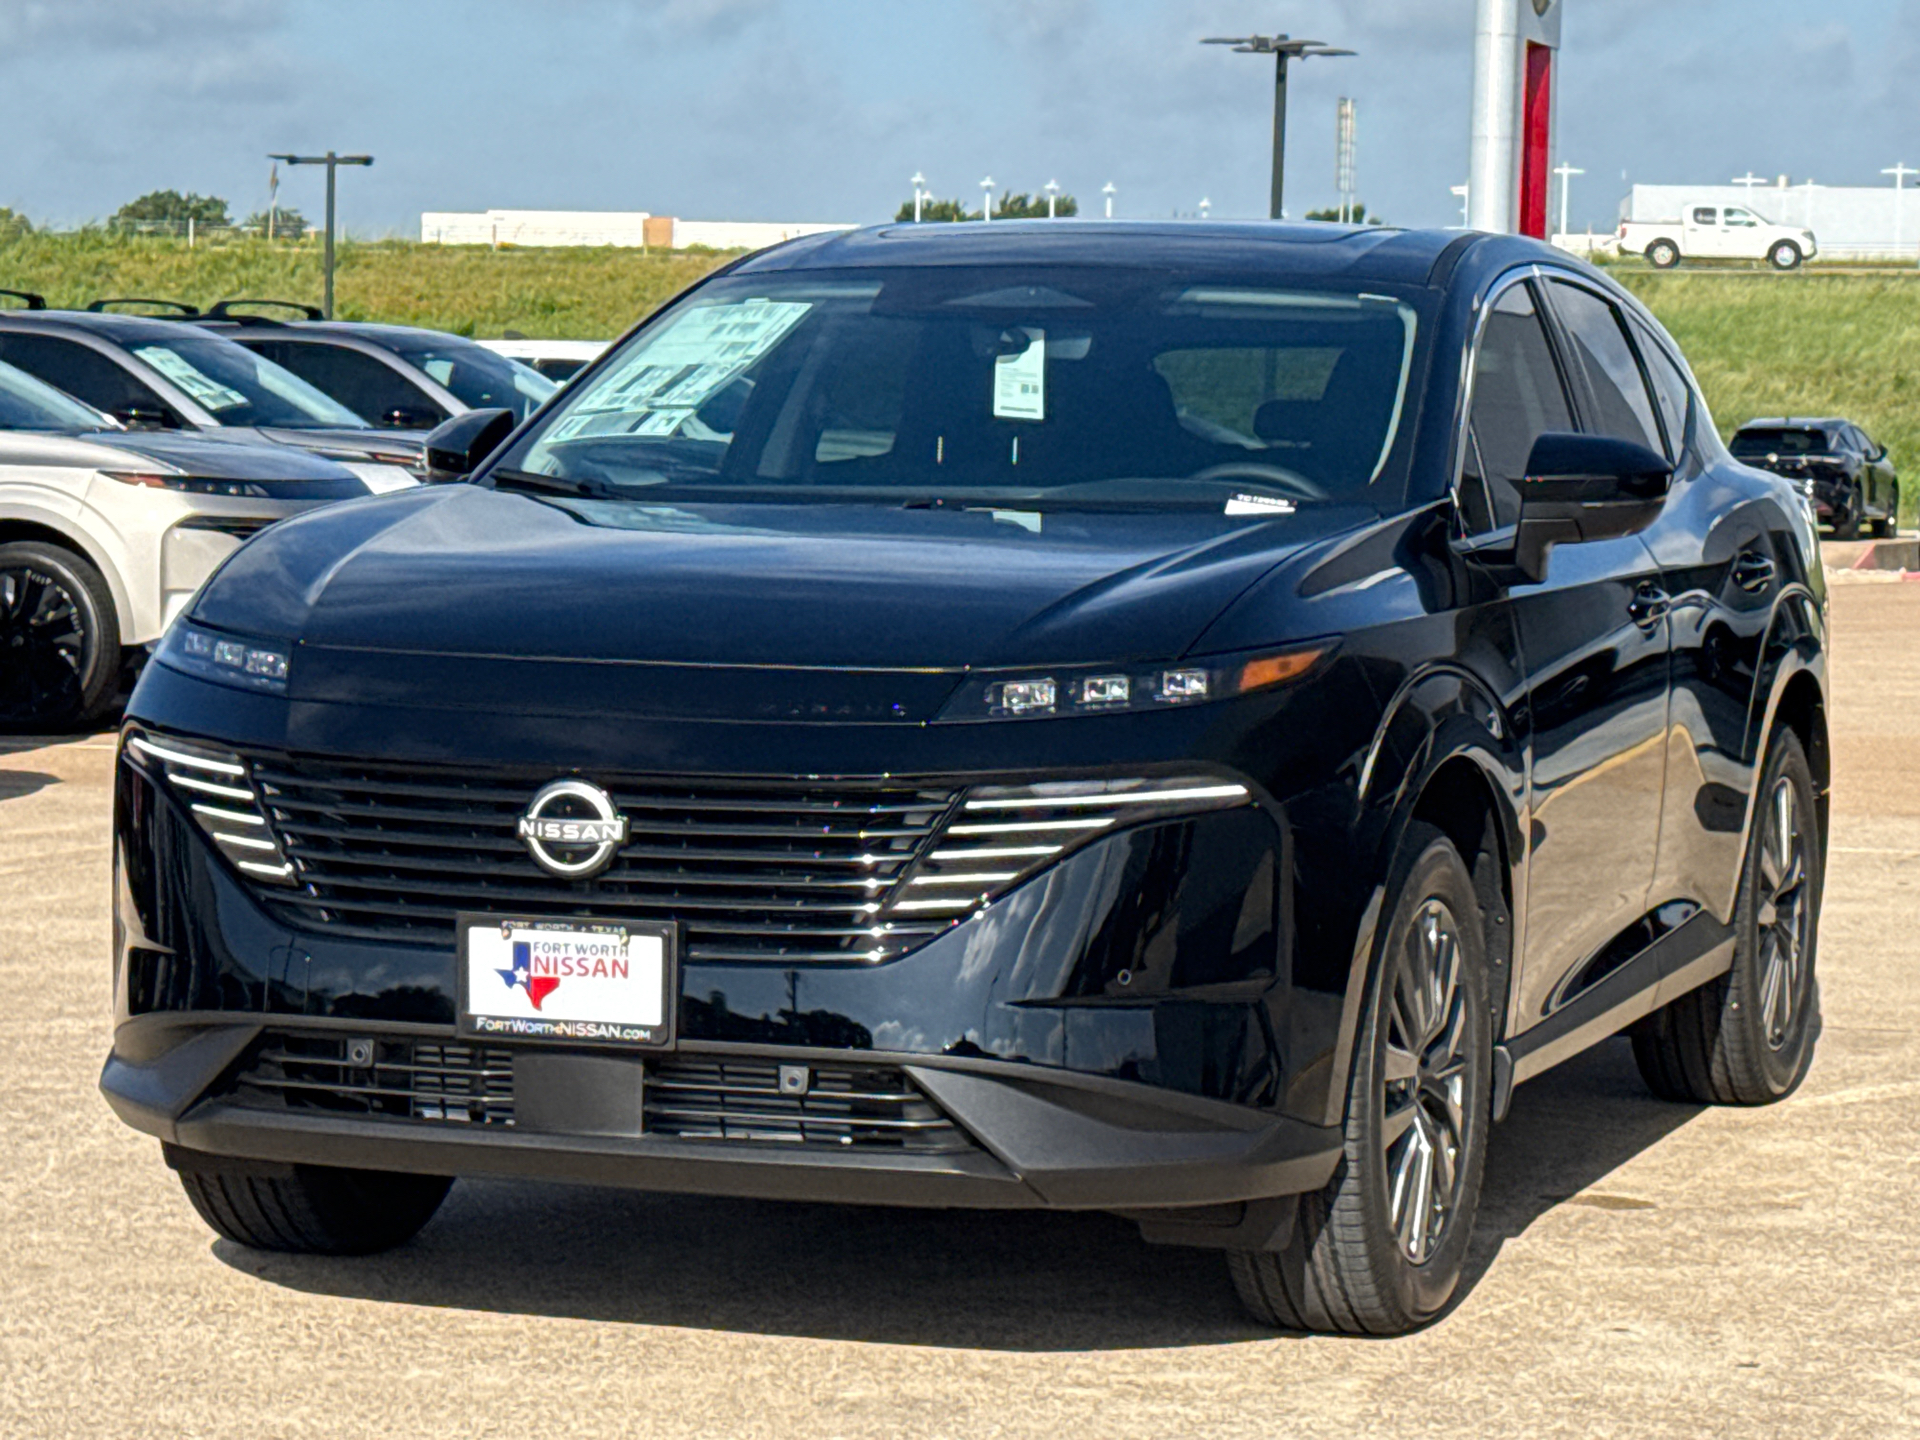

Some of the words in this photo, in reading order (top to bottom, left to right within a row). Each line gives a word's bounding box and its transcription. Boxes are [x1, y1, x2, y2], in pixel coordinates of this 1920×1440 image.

[520, 819, 623, 841] NISSAN
[533, 941, 571, 955] FORT
[575, 943, 629, 958] WORTH
[533, 955, 629, 979] NISSAN
